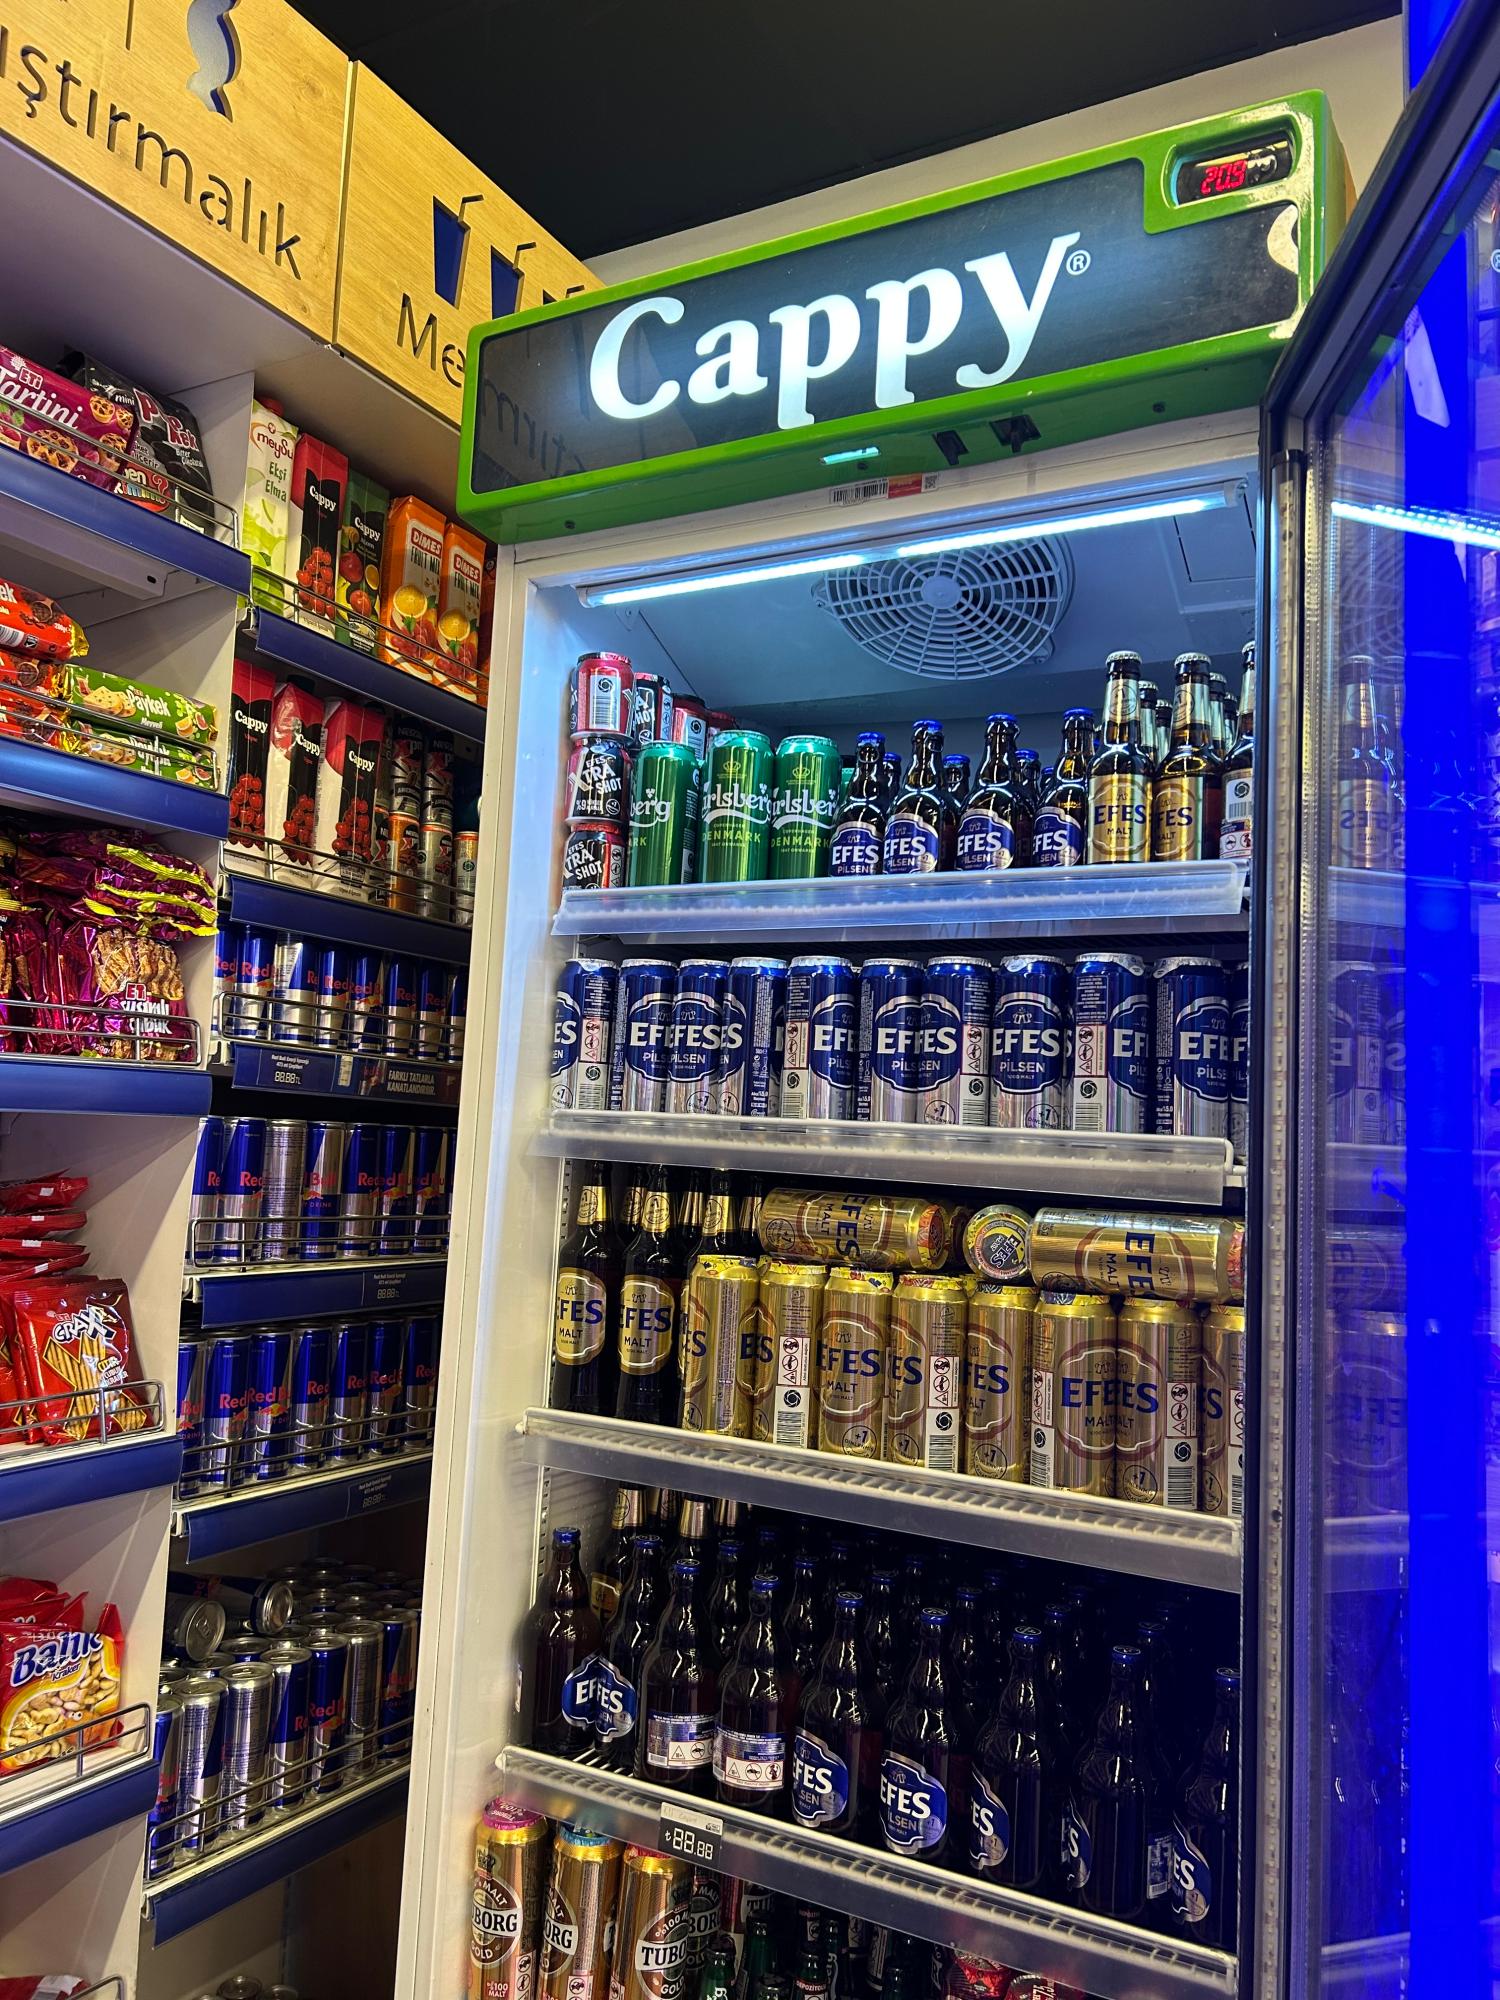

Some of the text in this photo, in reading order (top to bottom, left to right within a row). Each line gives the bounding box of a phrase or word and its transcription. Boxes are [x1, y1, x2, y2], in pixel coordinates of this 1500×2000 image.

[115, 394, 135, 406] mini
[269, 461, 287, 484] Ekşi
[265, 479, 287, 503] Elma
[309, 485, 337, 512] Cappy
[354, 516, 381, 541] Cappy
[126, 689, 171, 717] Paykek
[234, 708, 269, 734] Cappy
[348, 750, 375, 772] Cappy
[595, 777, 622, 795] SHOT
[1095, 804, 1147, 826] EFES
[702, 829, 761, 844] DENMARK
[1107, 827, 1133, 836] MALT
[957, 832, 1002, 856] EFES
[832, 844, 879, 866] EFES
[575, 860, 602, 880] SHOT
[241, 961, 270, 978] Red
[324, 975, 352, 990] Red
[992, 1028, 1060, 1057] EFES
[999, 1058, 1046, 1073] PİLSEN
[821, 1203, 834, 1235] MALT
[557, 1299, 603, 1325] FES
[559, 1326, 584, 1338] MALT
[624, 1336, 652, 1348] MALT
[370, 1370, 396, 1384] Red
[248, 1386, 277, 1403] Red
[828, 1381, 858, 1394] MALT
[219, 1389, 248, 1409] Red
[855, 1430, 868, 1443] +7
[1133, 1471, 1146, 1485] +7
[52, 1661, 81, 1682] Kraker
[310, 1702, 336, 1718] Red
[880, 1773, 931, 1819] EFES
[1173, 1848, 1195, 1891] ES
[482, 1880, 507, 1906] MALT
[545, 1920, 573, 1949] ORG
[488, 1990, 506, 1998] MALT
